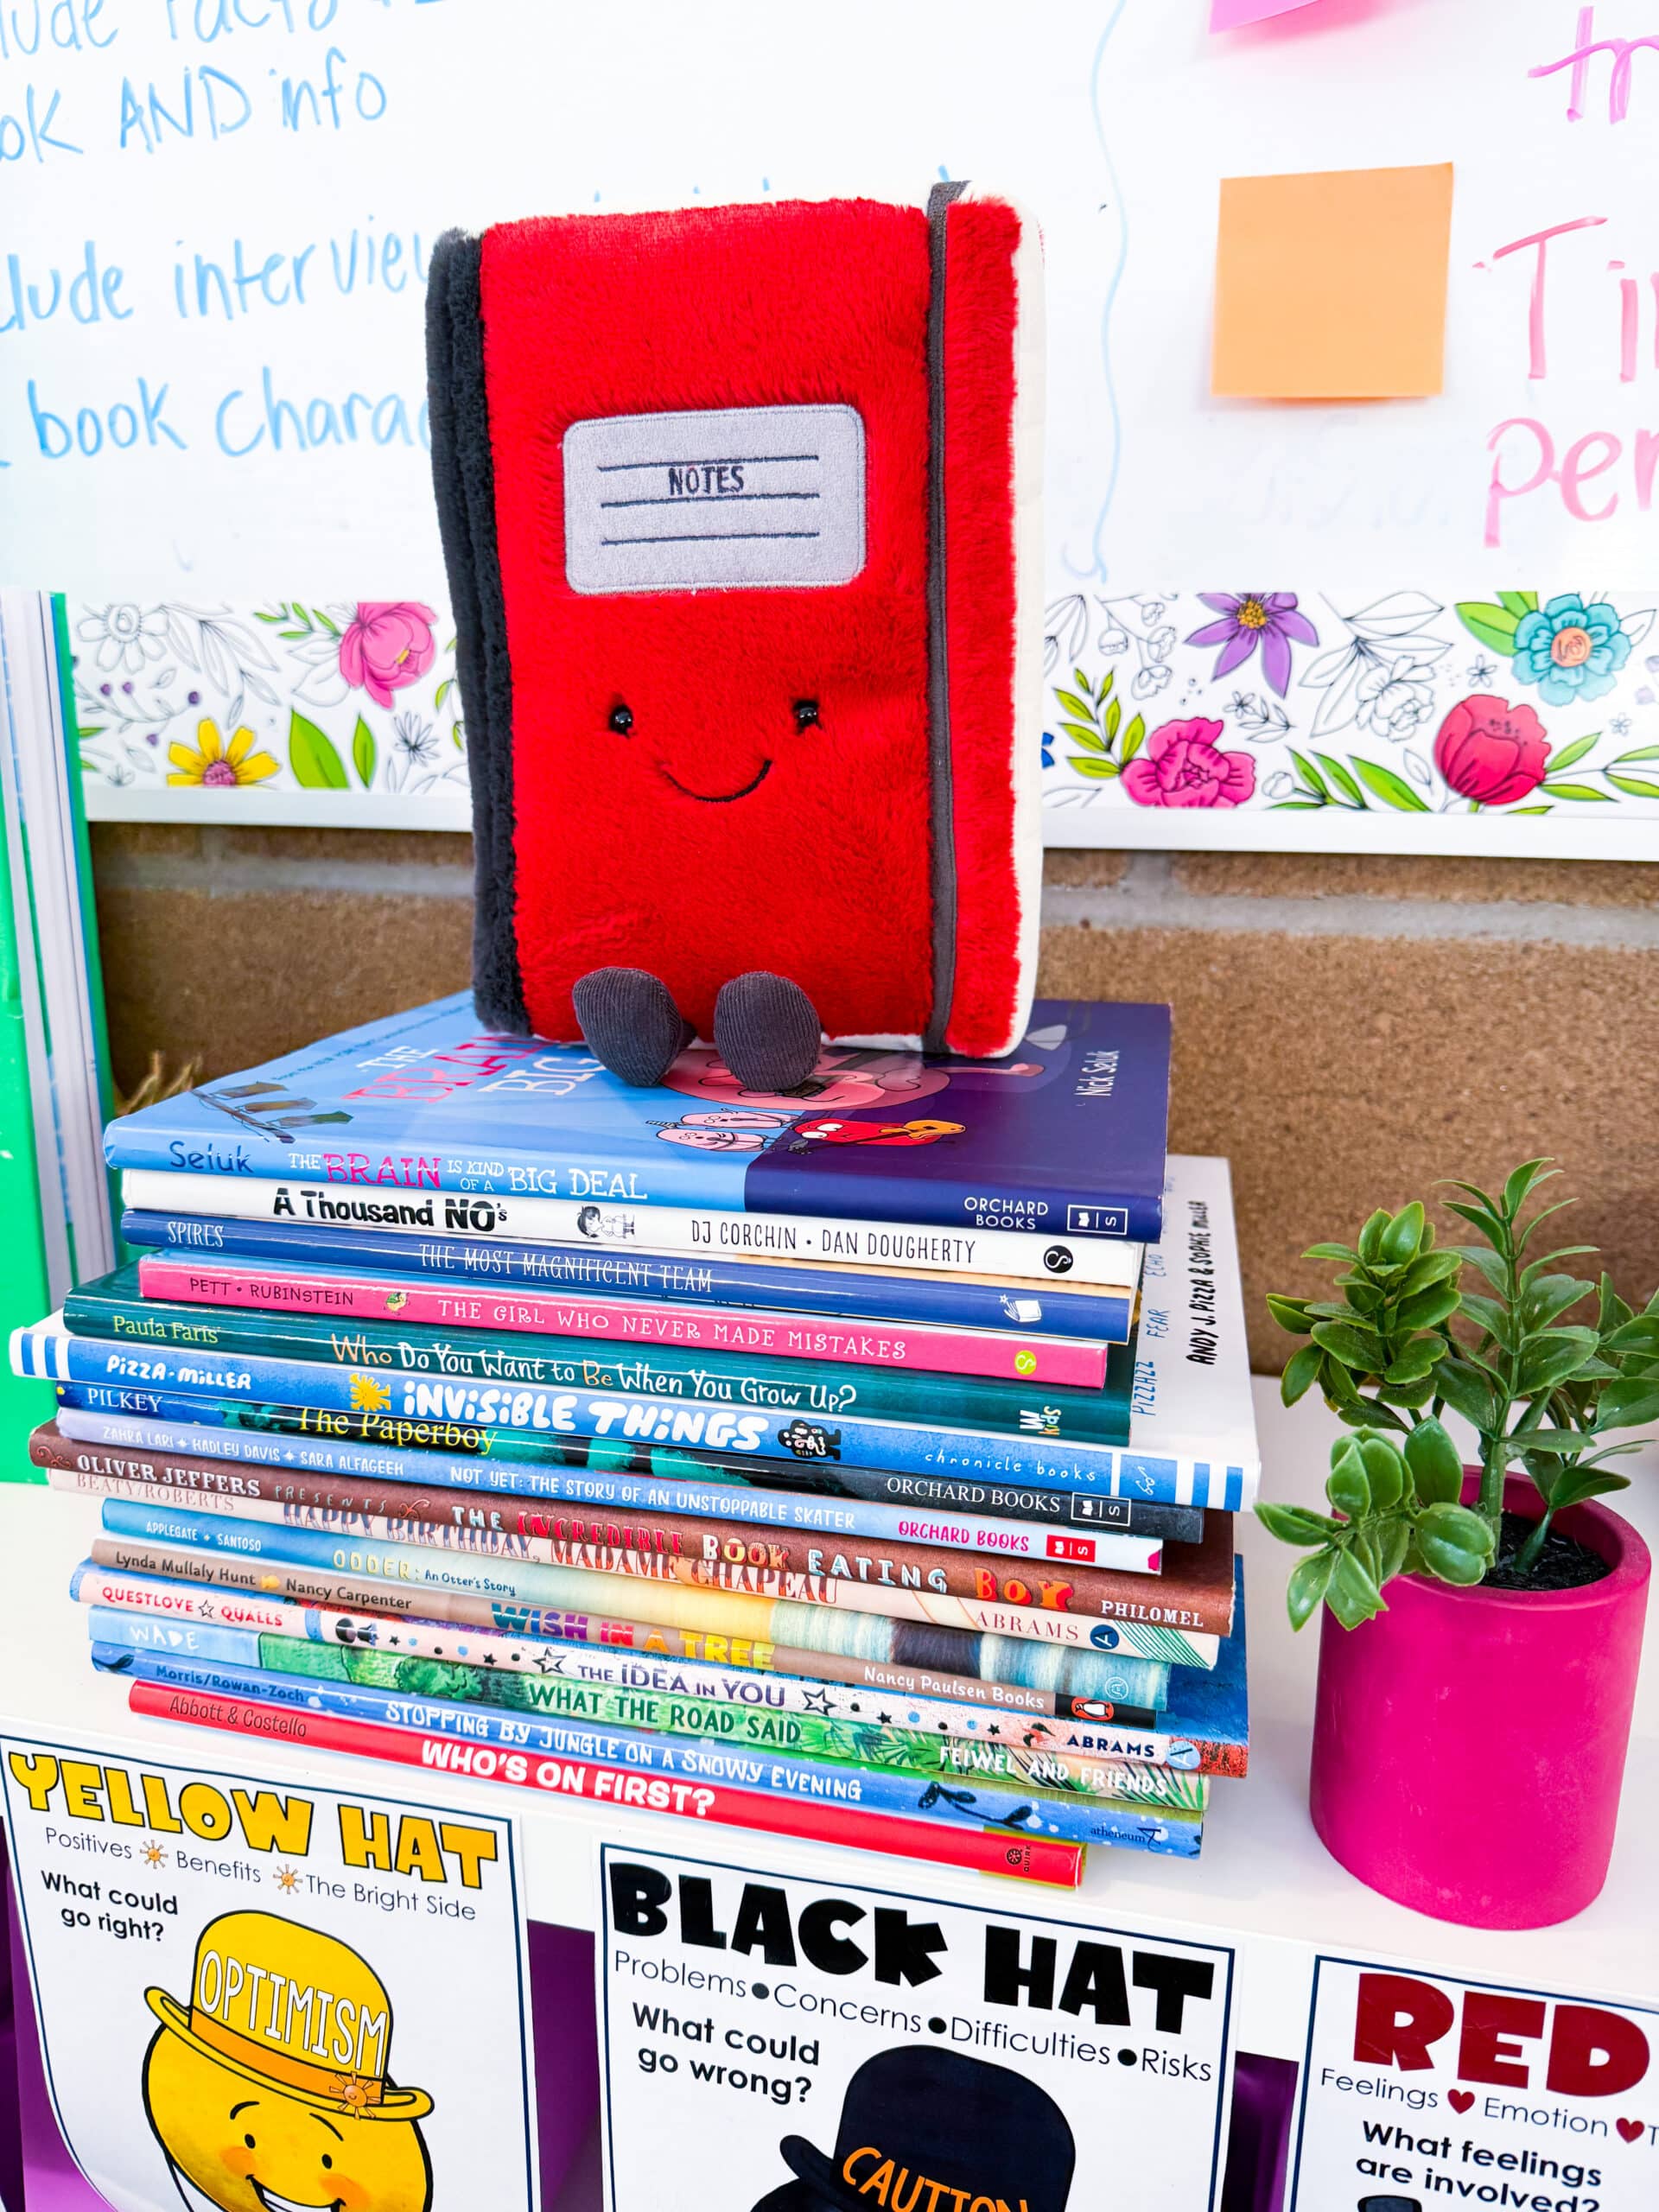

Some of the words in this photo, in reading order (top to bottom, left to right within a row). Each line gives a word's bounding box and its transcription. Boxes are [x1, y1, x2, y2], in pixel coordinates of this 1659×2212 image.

[121, 65, 252, 154] AND
[269, 46, 387, 131] info
[28, 378, 188, 459] book
[668, 466, 745, 496] NOTES
[1073, 1076, 1116, 1096] Nick
[289, 1153, 321, 1171] THE
[322, 1153, 442, 1189] BRAIN
[447, 1160, 462, 1174] IS
[460, 1178, 480, 1192] OF
[467, 1160, 505, 1178] KIND
[507, 1166, 556, 1195] BIG
[568, 1168, 648, 1200] DEAL
[273, 1187, 296, 1217] A
[299, 1189, 434, 1227] Thousand
[691, 1219, 711, 1244] DJ
[720, 1223, 798, 1250] CORCHIN
[822, 1230, 859, 1255] DAN
[867, 1233, 976, 1266] DOUGHERTY
[963, 1197, 1049, 1216] ORCHARD
[976, 1215, 1036, 1230] BOOKS
[167, 1222, 225, 1248] SPIRES
[419, 1243, 455, 1270] THE
[523, 1252, 652, 1287] MAGNIFICENT
[658, 1265, 714, 1294] TEAM
[1187, 1232, 1213, 1266] SOPHIE
[189, 1277, 232, 1297] PETT
[250, 1283, 354, 1307] RUBINSTEIN
[438, 1300, 482, 1320] THE
[493, 1306, 545, 1325] GIRL
[556, 1310, 609, 1331] WHO
[621, 1315, 702, 1340] NEVER
[714, 1324, 776, 1347] MADE
[787, 1331, 907, 1360] MISTAKES
[1146, 1308, 1170, 1338] FEAR
[1185, 1328, 1219, 1365] ANDY
[112, 1315, 166, 1338] Paula
[171, 1322, 220, 1344] Faris
[331, 1332, 392, 1366] Who
[397, 1341, 428, 1370] Do
[431, 1344, 474, 1376] You
[480, 1351, 545, 1381] Want
[550, 1359, 575, 1382] to
[616, 1362, 683, 1395] When
[689, 1370, 733, 1402] You
[741, 1376, 802, 1407] Grow
[809, 1384, 857, 1413] Up?
[86, 1387, 164, 1414] PILKEY
[361, 1410, 498, 1456] Paperboy
[887, 1477, 986, 1503] ORCHARD
[991, 1490, 1061, 1513] BOOKS
[925, 1450, 1022, 1472] chronicle
[1037, 1461, 1096, 1481] books
[103, 1427, 144, 1446] ZAHRA
[192, 1438, 240, 1458] HADLEY
[245, 1445, 281, 1462] DAVIS
[300, 1451, 334, 1468] SARA
[338, 1456, 404, 1476] ALFAGEEH
[450, 1466, 484, 1484] NOT
[529, 1476, 561, 1493] THE
[566, 1480, 615, 1501] STORY
[621, 1486, 641, 1502] OF
[647, 1490, 670, 1505] AN
[676, 1493, 787, 1522] UNSTOPPABLE
[794, 1506, 855, 1529] SKATER
[898, 1521, 970, 1545] ORCHARD
[976, 1530, 1029, 1552] BOOKS
[76, 1454, 158, 1484] OLIVER
[162, 1465, 261, 1497] JEFFERS
[274, 1485, 387, 1514] PRESENTS
[451, 1506, 504, 1532] THE
[517, 1511, 687, 1557] INCREDIBLE
[702, 1534, 791, 1571] BOOK
[807, 1548, 949, 1593] EATING
[974, 1567, 1075, 1612] BOY
[1100, 1599, 1204, 1628] PHILOMEL
[145, 1521, 198, 1541] APPLEGATE
[217, 1533, 262, 1552] SANTOSO
[483, 1580, 517, 1597] Story
[115, 1552, 156, 1570] Lynda
[162, 1559, 215, 1580] Mullaly
[219, 1569, 257, 1586] Hunt
[286, 1580, 332, 1600] Nancy
[337, 1586, 413, 1611] Carpenter
[490, 1602, 589, 1641] WISH
[678, 1630, 776, 1671] TREE
[863, 1666, 915, 1690] Nancy
[919, 1675, 987, 1700] Paulsen
[993, 1687, 1045, 1709] Books
[975, 1611, 1078, 1641] ABRAMS
[102, 1586, 194, 1613] QUESTLOVE
[220, 1606, 283, 1627] QUALLS
[576, 1664, 615, 1681] THE
[722, 1678, 785, 1707] YOU
[1066, 1734, 1155, 1758] ABRAMS
[129, 1624, 200, 1650] WADE
[529, 1682, 604, 1714] WHAT
[614, 1695, 658, 1724] THE
[671, 1704, 734, 1734] ROAD
[747, 1714, 802, 1744] SAID
[940, 1745, 1017, 1775] FEIWEL
[1027, 1758, 1070, 1782] AND
[1081, 1766, 1167, 1796] FRIENDS
[169, 1695, 224, 1722] Abbott
[243, 1708, 308, 1738] Costello
[422, 1740, 529, 1782] WHO'S
[537, 1761, 586, 1795] ON
[594, 1771, 716, 1816] FIRST?
[385, 1701, 490, 1738] STOPPING
[539, 1726, 619, 1760] JUNGLE
[626, 1743, 656, 1765] ON
[771, 1766, 863, 1802] EVENING
[1090, 1826, 1146, 1844] atheneum
[8, 1751, 315, 1857] YELLOW
[336, 1804, 499, 1891] HAT
[40, 1869, 102, 1903] What
[108, 1887, 179, 1916] could
[44, 1827, 133, 1861] Positives
[175, 1850, 262, 1885] Benefits
[306, 1873, 346, 1899] The
[353, 1883, 419, 1915] Bright
[426, 1895, 477, 1921] Side
[60, 1906, 92, 1929] go
[98, 1914, 165, 1942] right?
[608, 1861, 949, 1988] BLACK
[983, 1923, 1216, 2036] HAT
[199, 1949, 388, 2078] OPTIMISM
[613, 1949, 747, 1999] Problems
[773, 1982, 922, 2036] Concerns
[950, 2016, 1112, 2068] Difficulties
[1141, 2048, 1212, 2082] Risks
[632, 2000, 715, 2045] What
[724, 2025, 821, 2068] could
[1353, 1973, 1650, 2097] RED
[637, 2044, 679, 2075] go
[690, 2056, 813, 2107] wrong?
[1321, 2068, 1439, 2109] Feelings
[1484, 2097, 1608, 2137] Emotion
[1356, 2158, 1413, 2184] are
[1425, 2168, 1600, 2212] involved?
[1363, 2120, 1452, 2158] What
[1461, 2141, 1602, 2186] feelings
